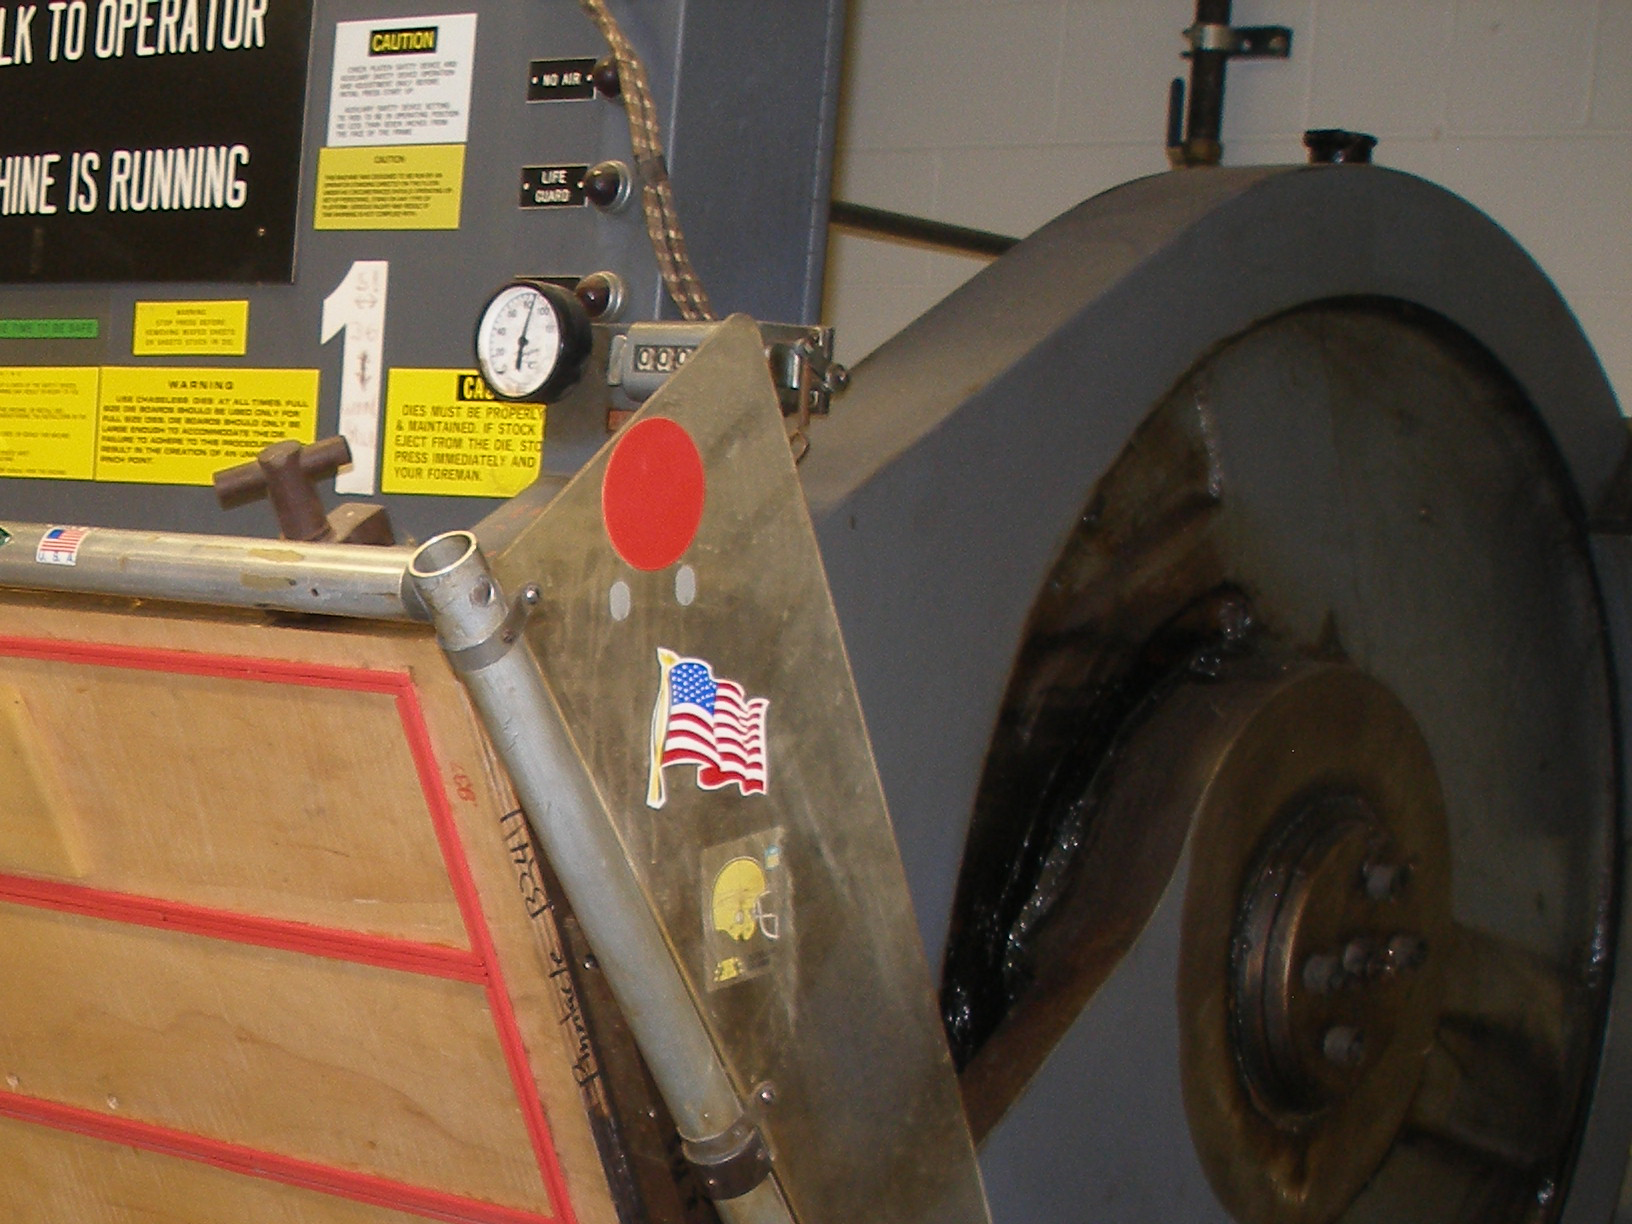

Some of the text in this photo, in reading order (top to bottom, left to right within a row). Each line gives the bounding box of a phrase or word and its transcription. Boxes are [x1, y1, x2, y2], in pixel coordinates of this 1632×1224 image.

[48, 0, 87, 62] TO
[94, 0, 268, 59] OPERATOR
[372, 31, 434, 51] CAUTION
[543, 72, 581, 86] NO AIR
[67, 151, 100, 213] IS
[108, 144, 250, 212] RUNNING
[541, 170, 567, 184] LIFE
[535, 189, 571, 202] GUARD
[320, 260, 389, 496] 1
[169, 381, 234, 390] WARNING
[402, 405, 427, 417] DIES
[432, 406, 461, 417] MUST
[468, 407, 480, 419] BE
[396, 422, 404, 431] &
[483, 423, 493, 434] IF
[499, 423, 535, 436] STOCK
[395, 435, 427, 447] EJECT
[432, 437, 463, 449] FROM
[469, 439, 488, 450] THE
[394, 451, 534, 468] PRESS IMMEDIATELY AND
[394, 467, 423, 479] YOUR
